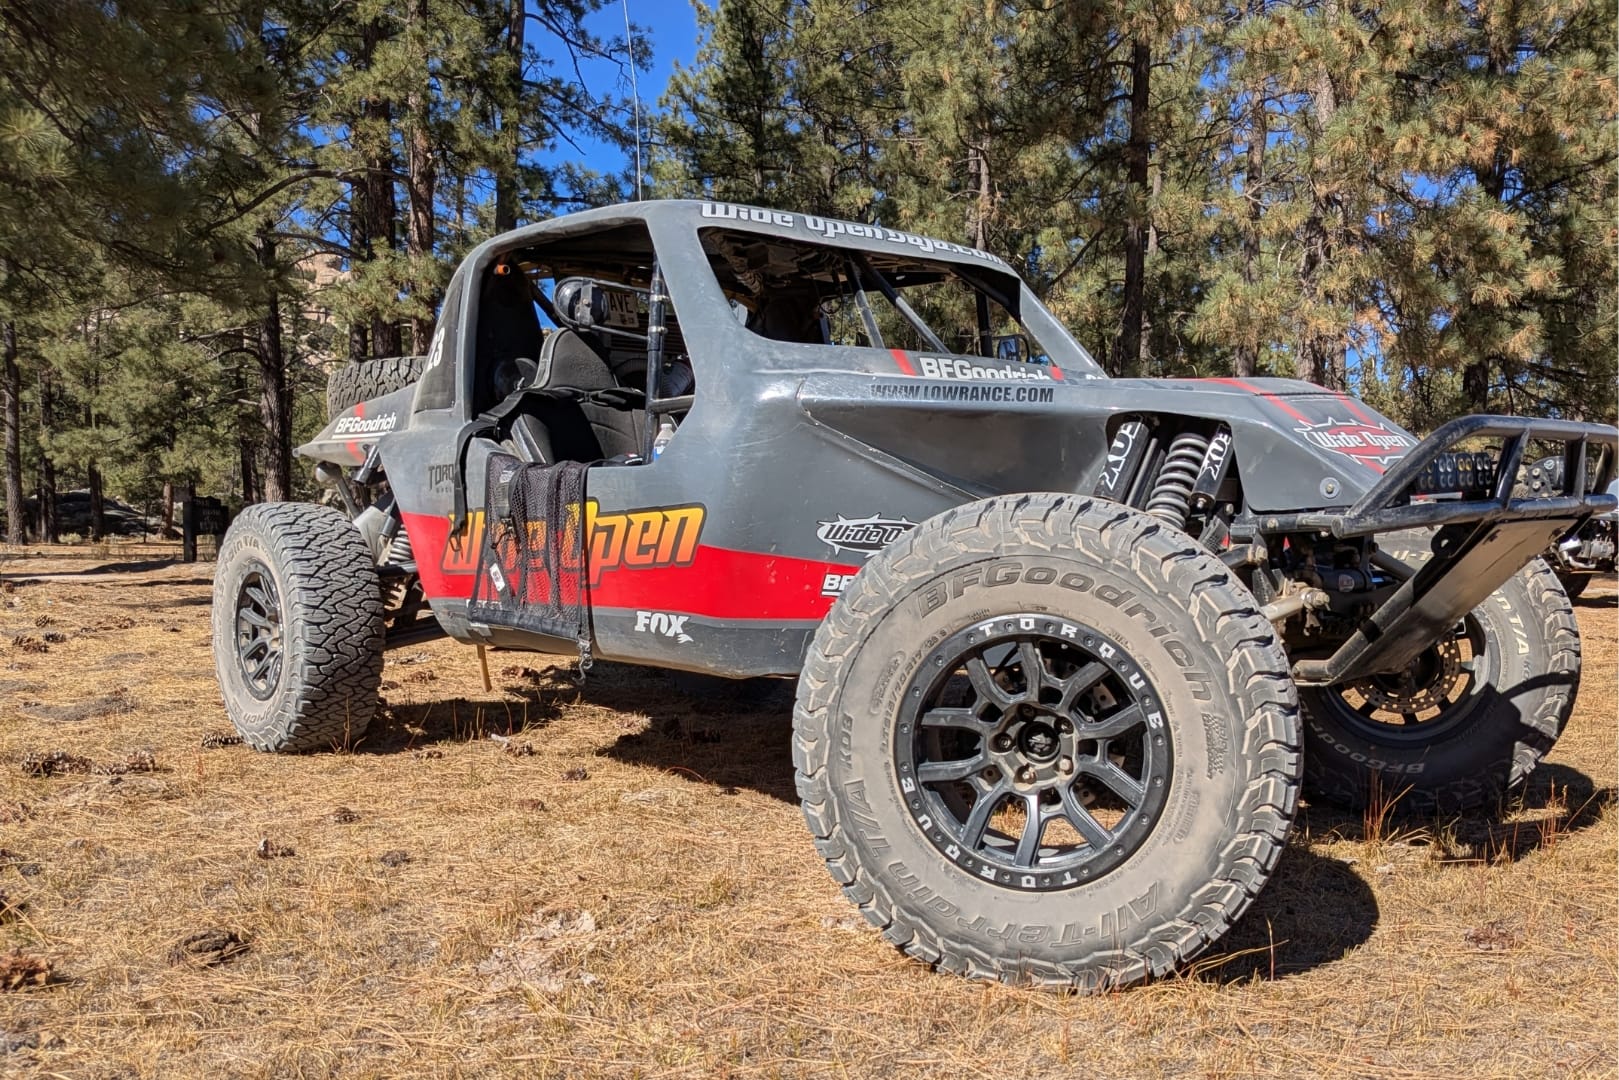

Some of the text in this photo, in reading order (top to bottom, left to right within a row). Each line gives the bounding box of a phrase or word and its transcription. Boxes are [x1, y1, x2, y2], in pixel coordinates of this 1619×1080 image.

[701, 202, 794, 228] Wide
[870, 383, 1054, 403] WWW.LOWRANCE.COM
[334, 412, 397, 434] BFGoodrich
[1309, 431, 1410, 450] Wide Open
[428, 463, 455, 491] TORQ
[1098, 422, 1142, 491] FOX
[1200, 432, 1232, 481] FOX
[561, 496, 706, 588] Open
[823, 523, 883, 544] Wide
[634, 611, 691, 638] FOX
[917, 562, 1212, 702] BFGoodrich
[979, 617, 1164, 729] TORQUE
[1300, 700, 1425, 774] BFGoodri
[844, 778, 890, 858] T/A
[887, 860, 1160, 948] All-Terrain
